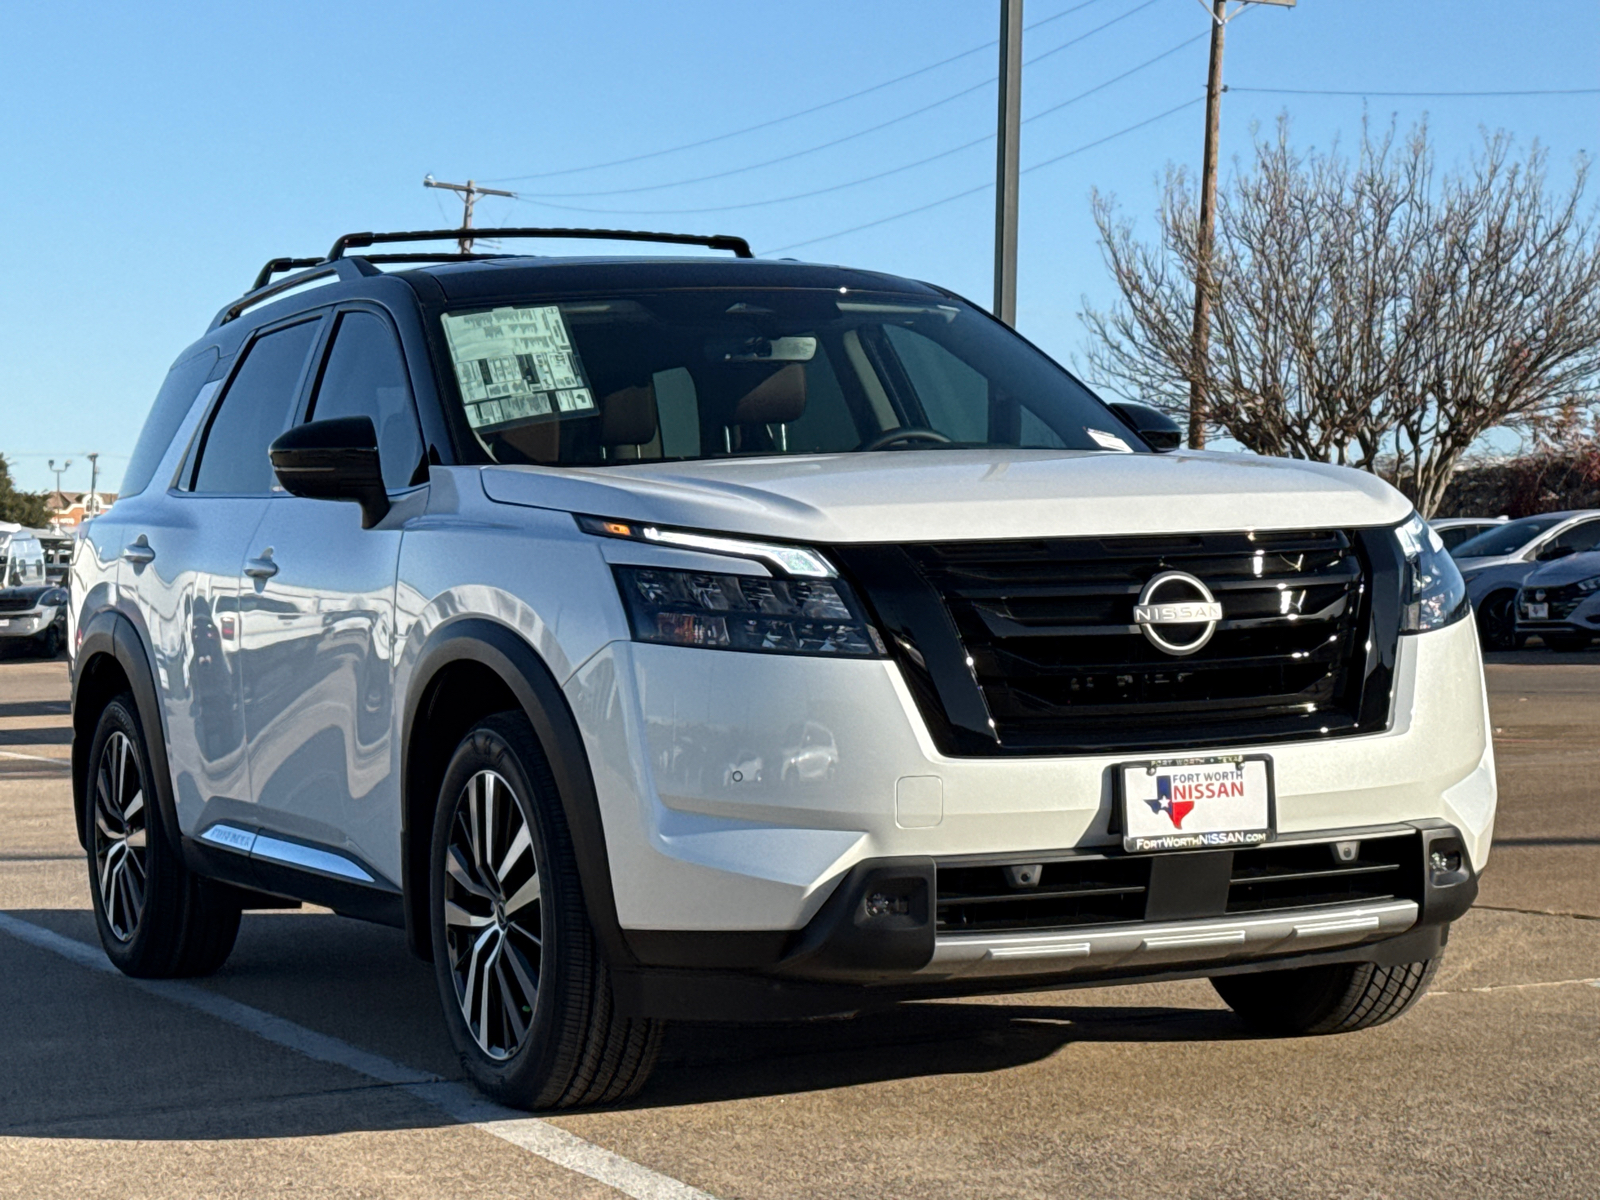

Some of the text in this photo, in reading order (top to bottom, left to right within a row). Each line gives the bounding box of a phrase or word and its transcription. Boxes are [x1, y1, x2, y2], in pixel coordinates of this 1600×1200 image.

[1135, 606, 1219, 621] NISSAN
[1175, 757, 1205, 766] WORTH
[1172, 770, 1244, 784] FORT WORTH
[1173, 781, 1245, 800] NISSAN
